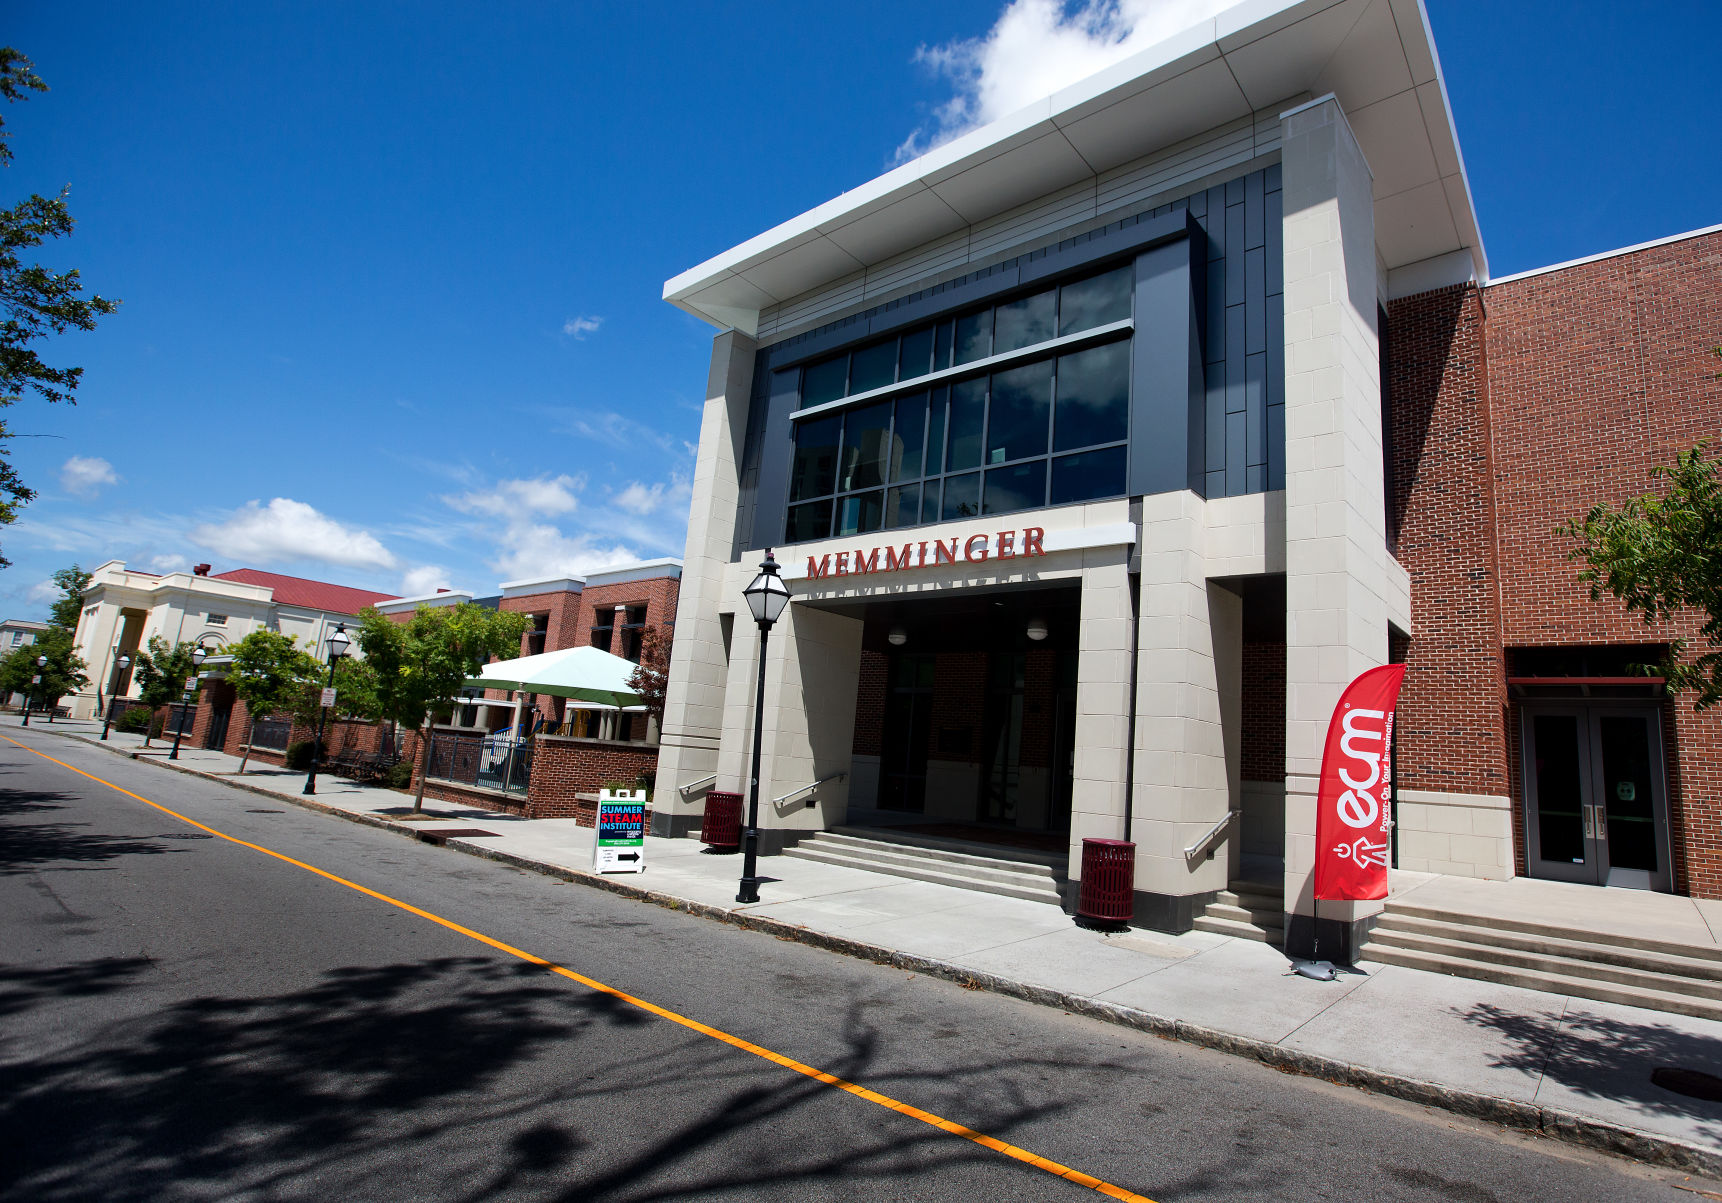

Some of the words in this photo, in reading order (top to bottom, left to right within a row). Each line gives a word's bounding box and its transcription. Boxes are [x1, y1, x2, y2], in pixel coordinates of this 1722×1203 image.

[806, 526, 1048, 580] MEMMINGER
[1381, 711, 1395, 762] Imagination
[1336, 708, 1384, 828] ecm
[1381, 764, 1389, 784] Your
[601, 806, 643, 814] SUMMER
[601, 813, 642, 823] STEAM
[600, 822, 641, 830] INSTITUTE
